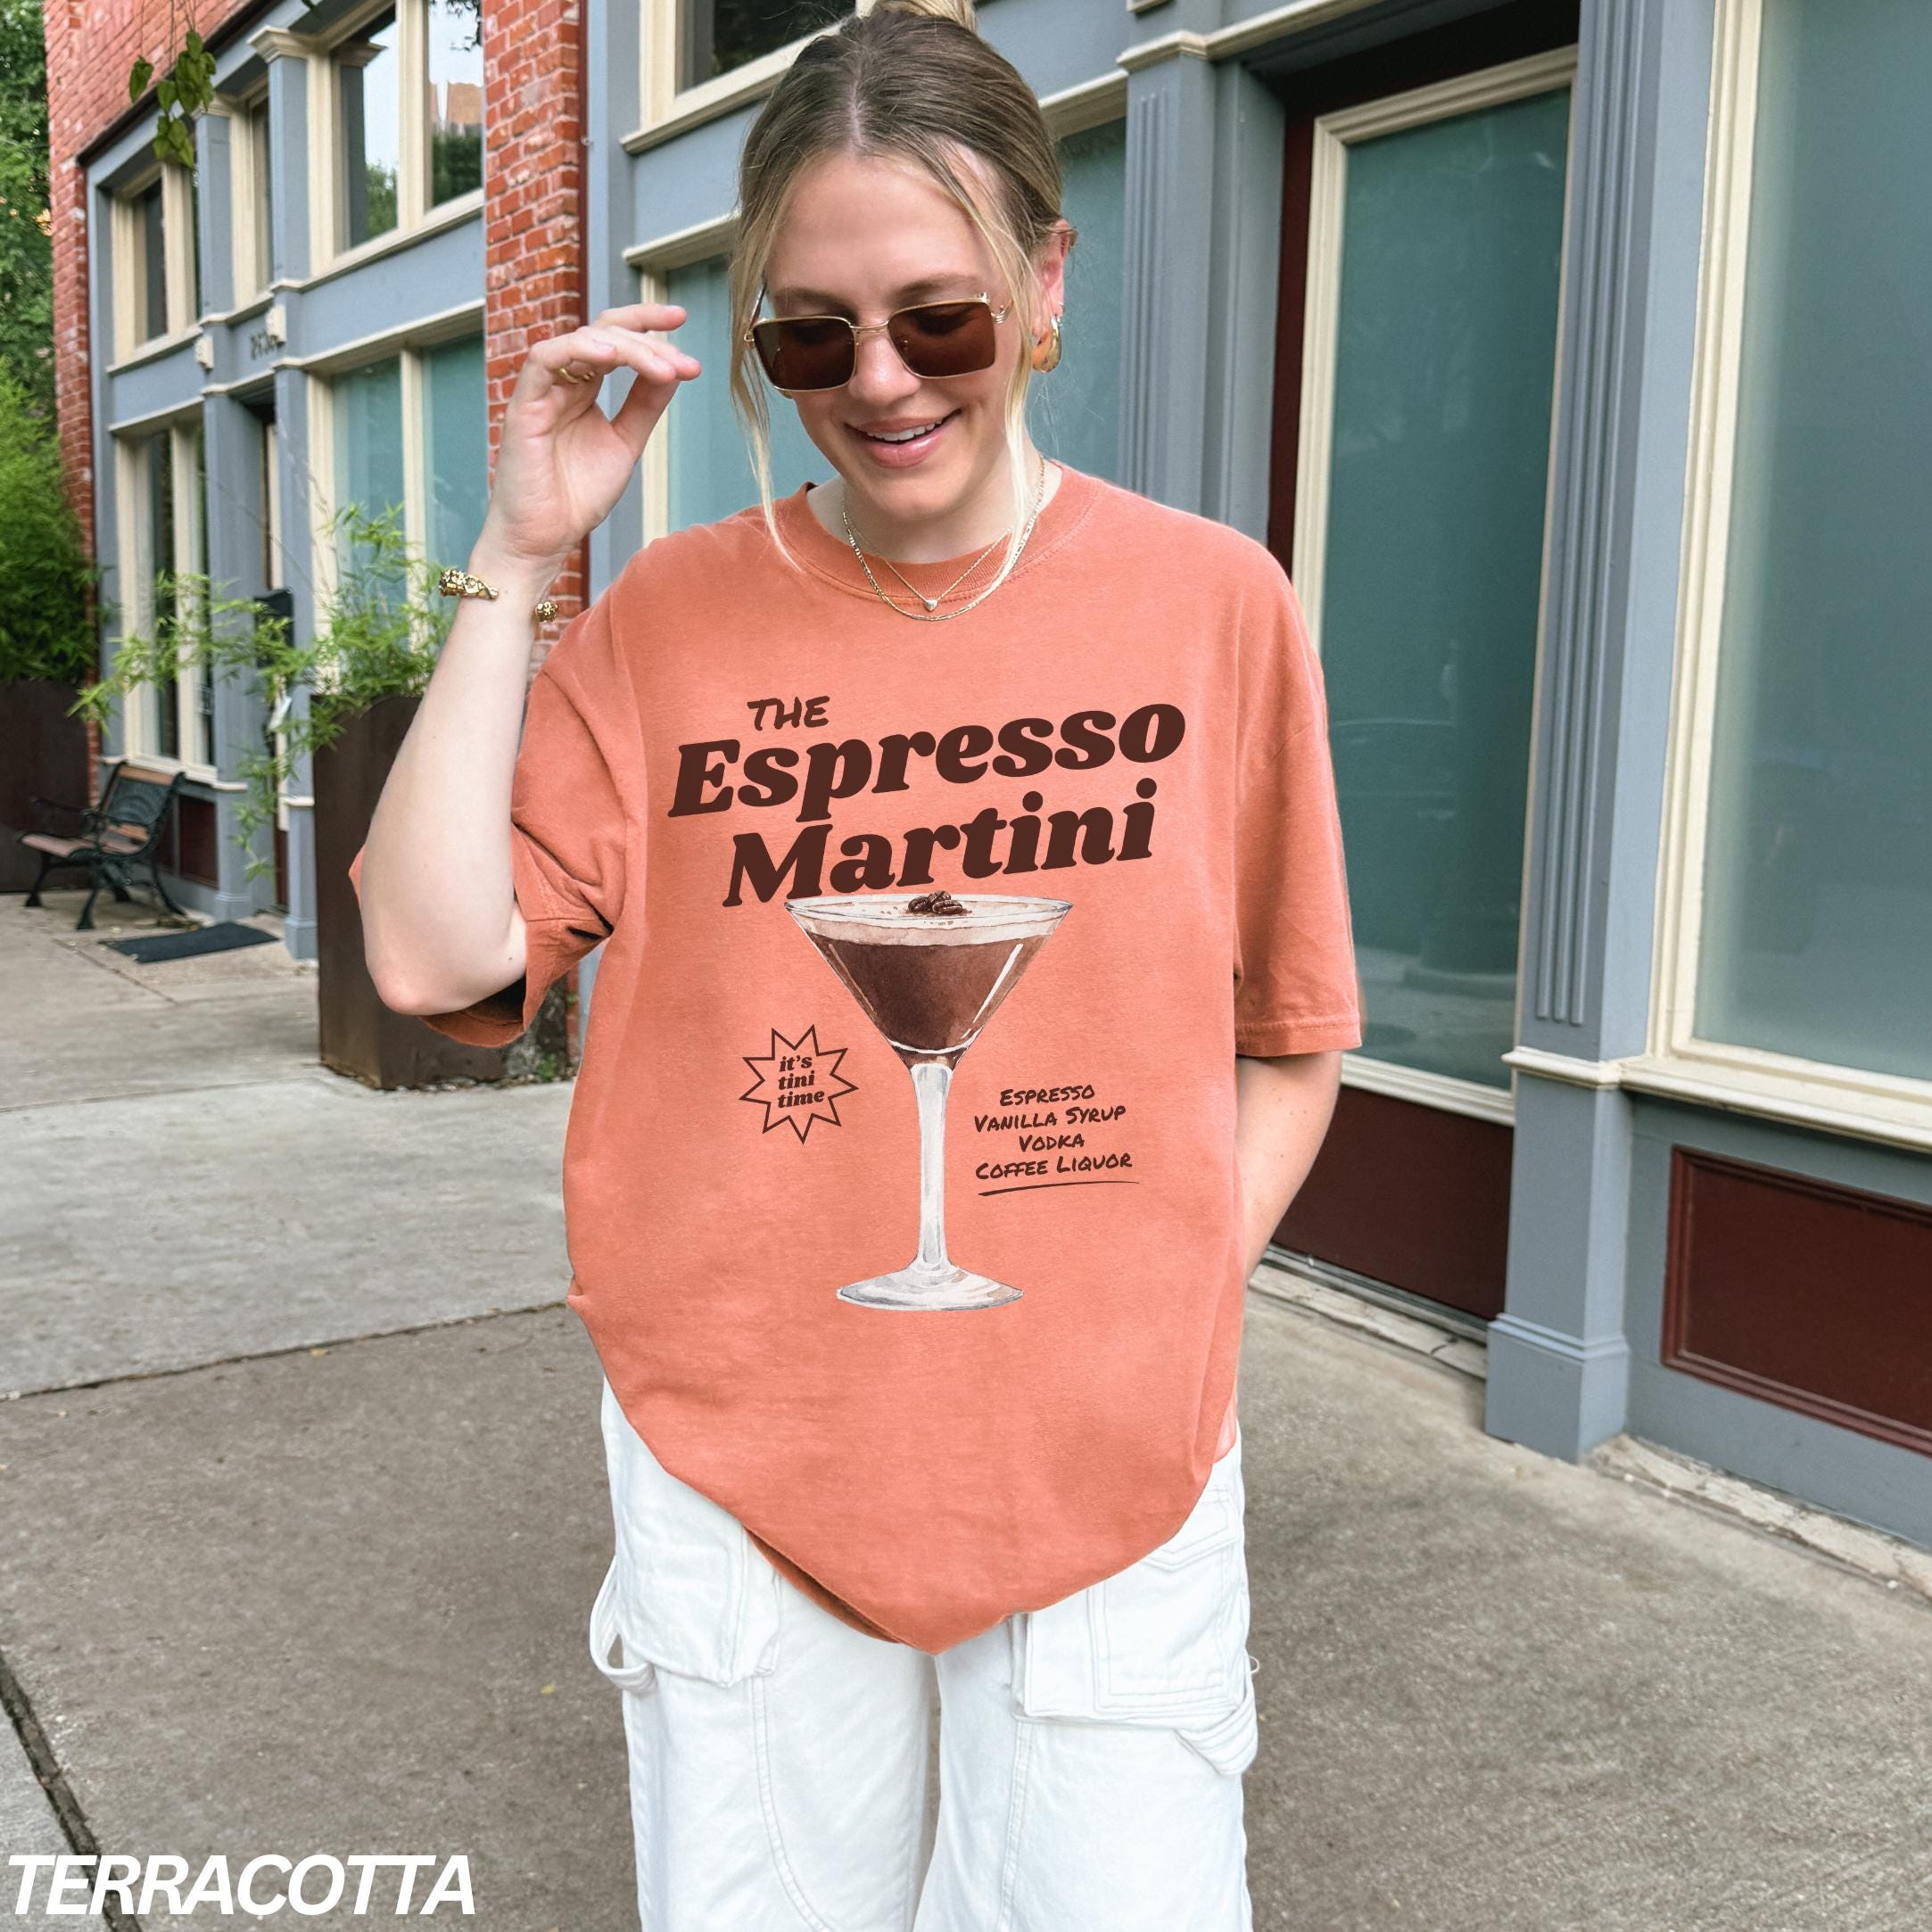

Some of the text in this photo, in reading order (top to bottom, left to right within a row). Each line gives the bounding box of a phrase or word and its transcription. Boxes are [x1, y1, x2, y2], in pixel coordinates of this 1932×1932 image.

[747, 695, 831, 731] THE
[667, 702, 1186, 822] Espresso
[722, 777, 1159, 908] Martini
[779, 1054, 813, 1072] it's
[777, 1069, 815, 1090] tini
[777, 1089, 825, 1109] time
[999, 1084, 1096, 1106] ESPRESSO
[973, 1104, 1127, 1133] VANILLA SYRUP
[1018, 1133, 1085, 1152] VODKA
[975, 1152, 1133, 1180] COFFEE LIQUOR
